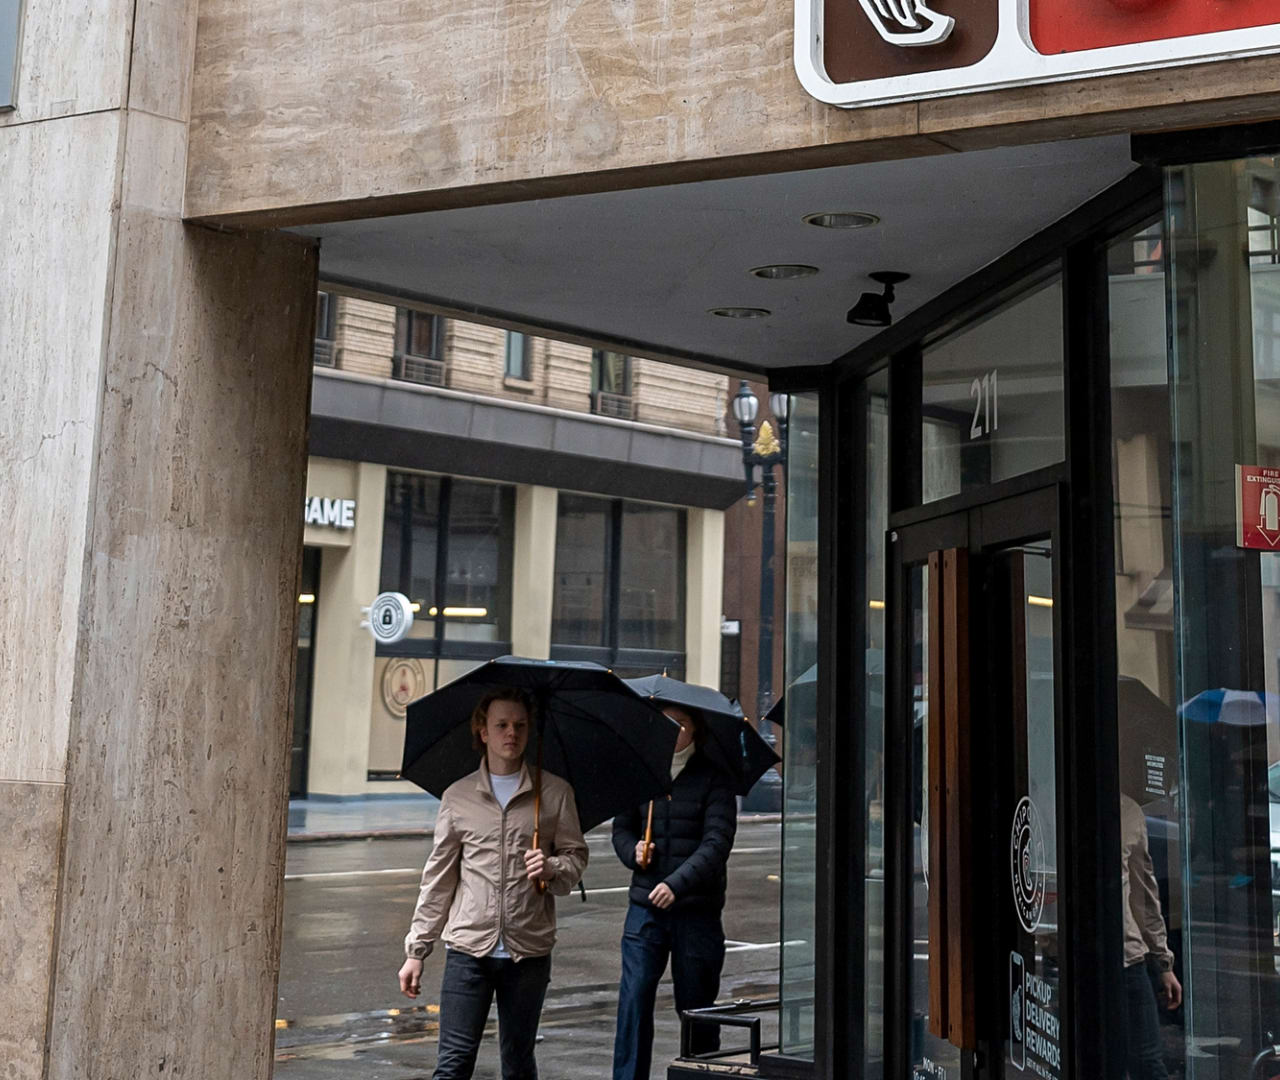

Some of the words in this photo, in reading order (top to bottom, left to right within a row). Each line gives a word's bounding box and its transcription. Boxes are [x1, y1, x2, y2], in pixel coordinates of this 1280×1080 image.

[970, 369, 997, 440] 211
[1026, 971, 1051, 1005] PICKUP
[1026, 999, 1060, 1040] DELIVERY
